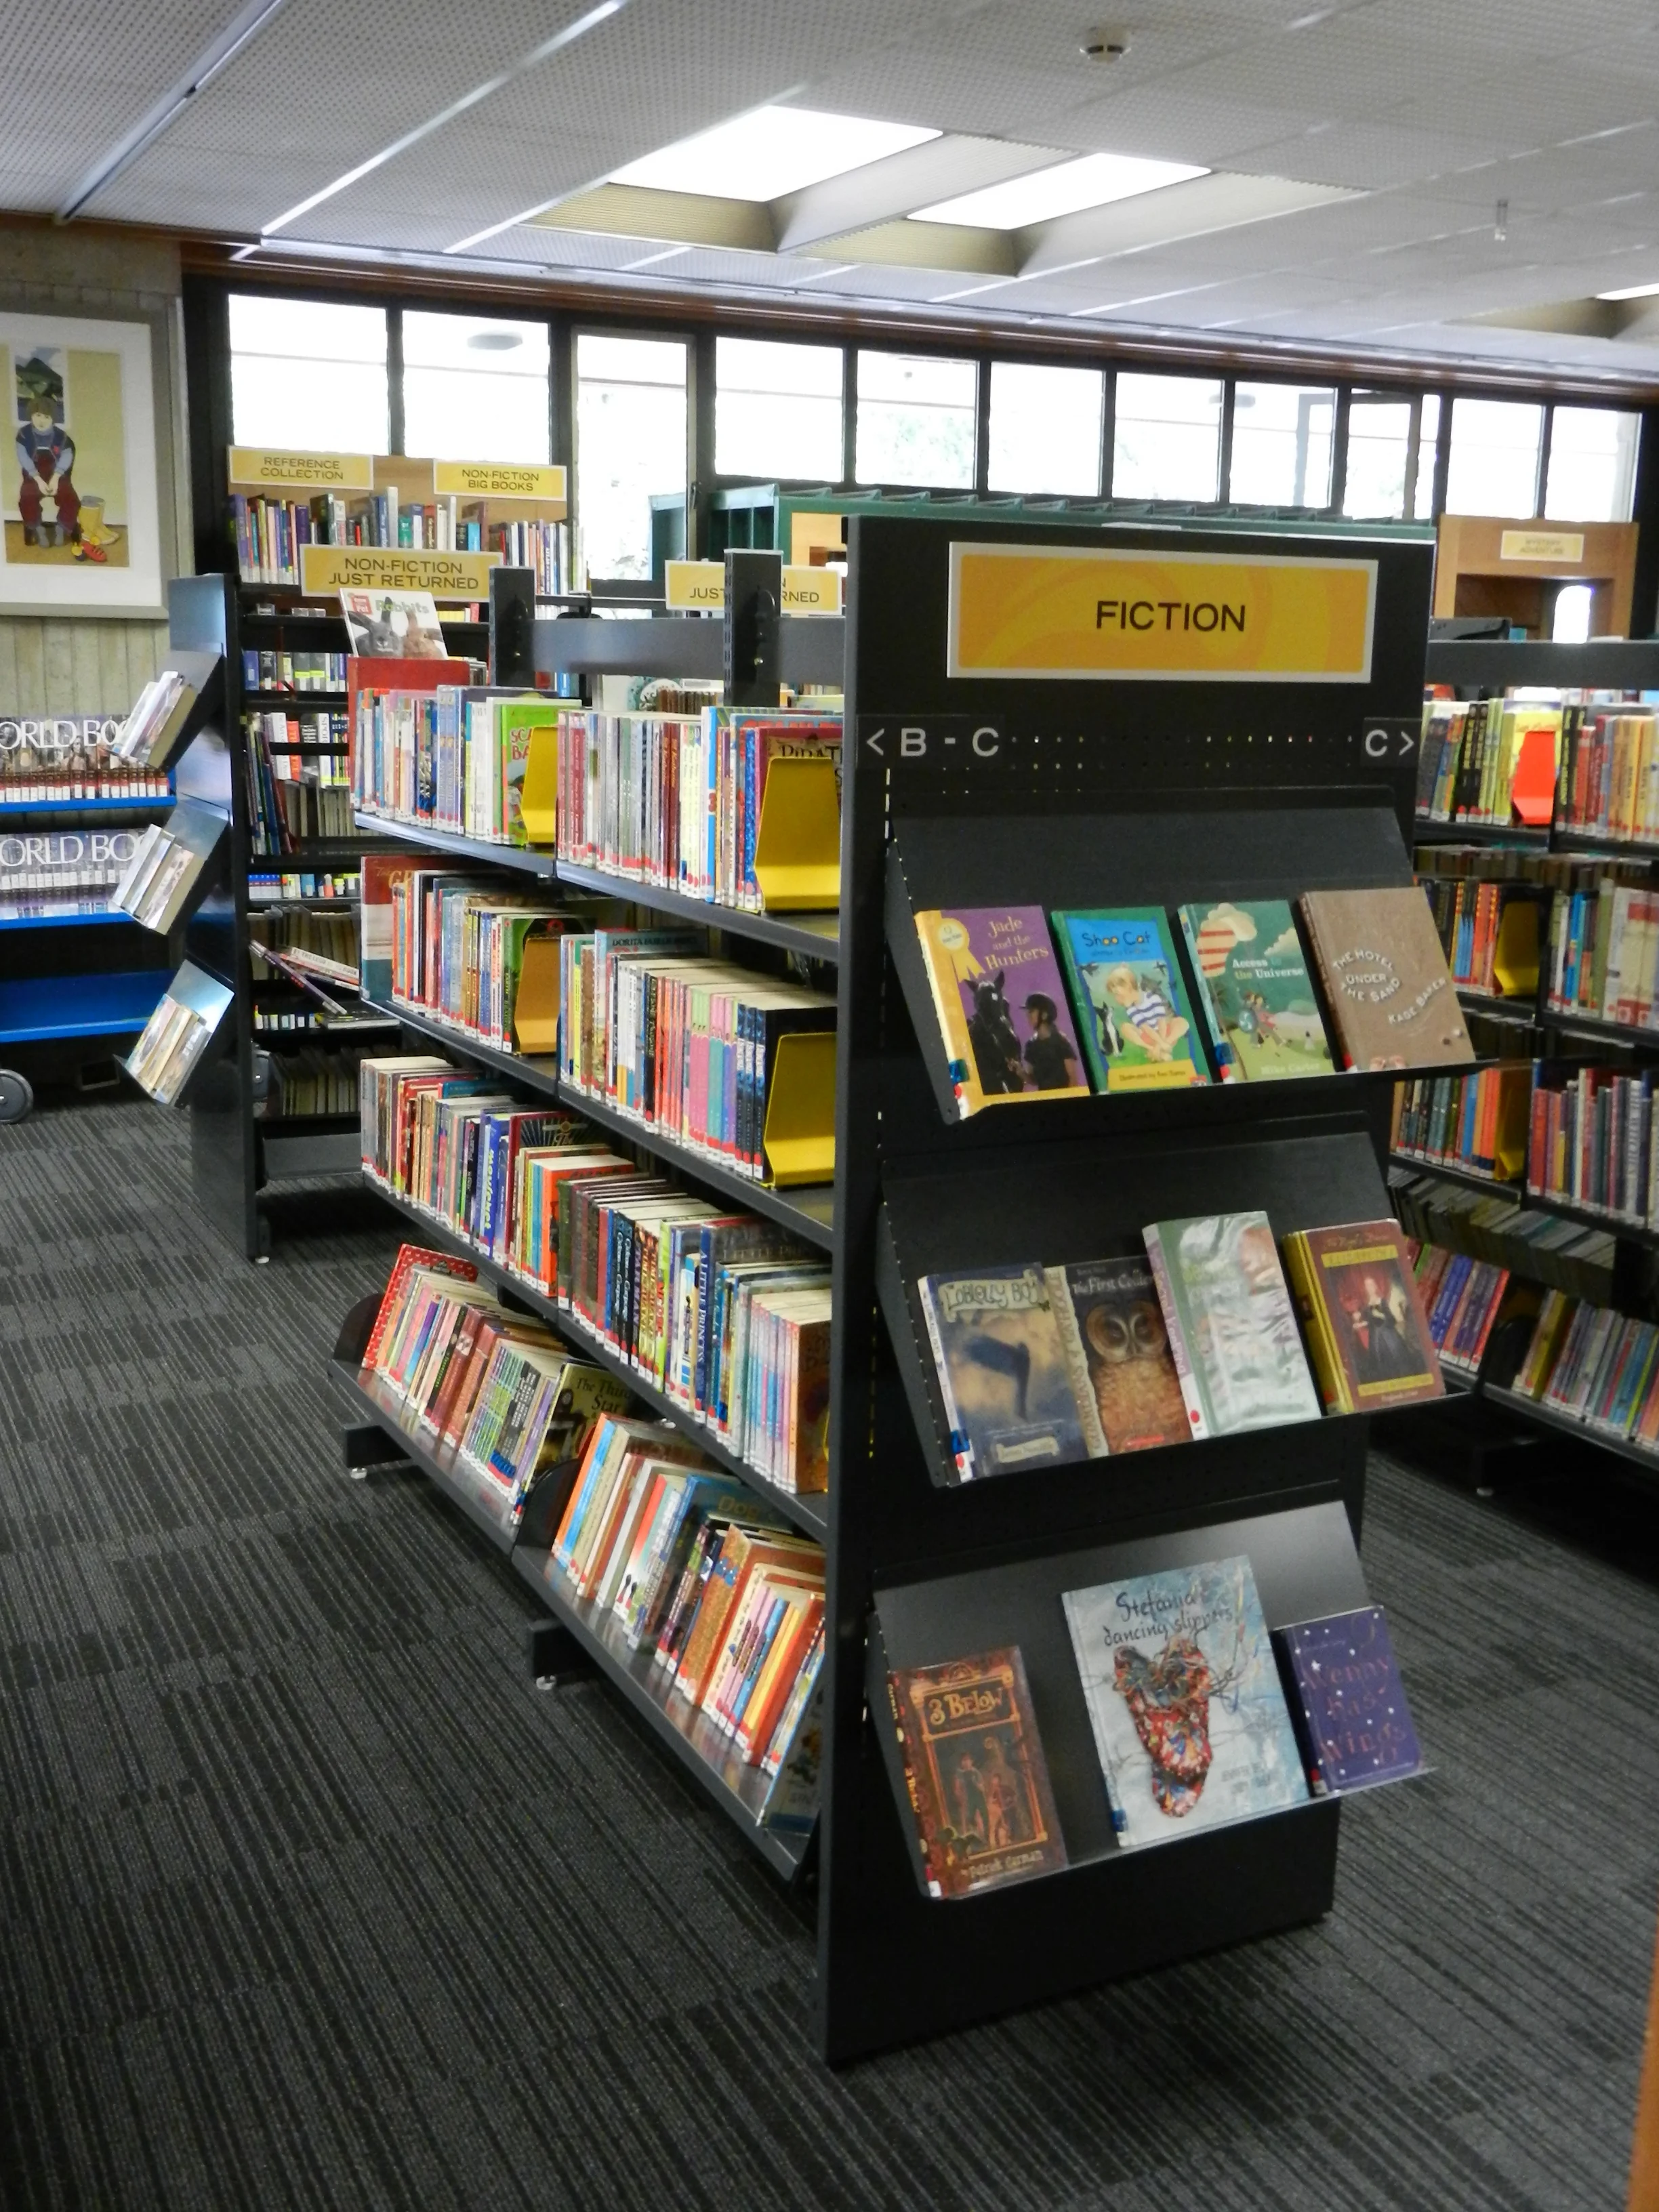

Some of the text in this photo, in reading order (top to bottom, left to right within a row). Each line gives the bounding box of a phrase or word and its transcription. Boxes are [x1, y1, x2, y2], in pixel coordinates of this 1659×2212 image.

[260, 467, 344, 480] COLLECTION
[264, 456, 340, 470] REFERENCE
[462, 468, 539, 482] NON-FICTION
[468, 480, 533, 492] BIG BOOKS
[344, 557, 463, 575] NON-FICTION
[328, 572, 479, 590] JUST RETURNED
[375, 598, 430, 613] Rabbits
[1095, 599, 1247, 634] FICTION
[0, 718, 130, 750] ORLD BO
[899, 727, 928, 757] B
[970, 726, 1000, 758] C
[1364, 728, 1389, 758] C
[0, 835, 83, 867] ORLD
[988, 916, 1023, 939] Jade
[992, 935, 1031, 950] and the
[1082, 930, 1150, 947] Shoo Cat
[985, 947, 1049, 970] Hunters
[1232, 958, 1268, 968] Access
[1332, 949, 1395, 972] THE HOTEL
[1235, 967, 1305, 980] the Universe
[1345, 973, 1387, 985] UNDER
[1340, 977, 1400, 1002] THE SAND
[1388, 977, 1446, 1025] KAGE BAKER
[699, 1263, 708, 1305] LITTLE
[697, 1309, 706, 1363] PRINCESS
[576, 1377, 596, 1392] The
[591, 1393, 621, 1413] Star
[1103, 1607, 1233, 1647] dancing slippers
[928, 1698, 945, 1725] 3
